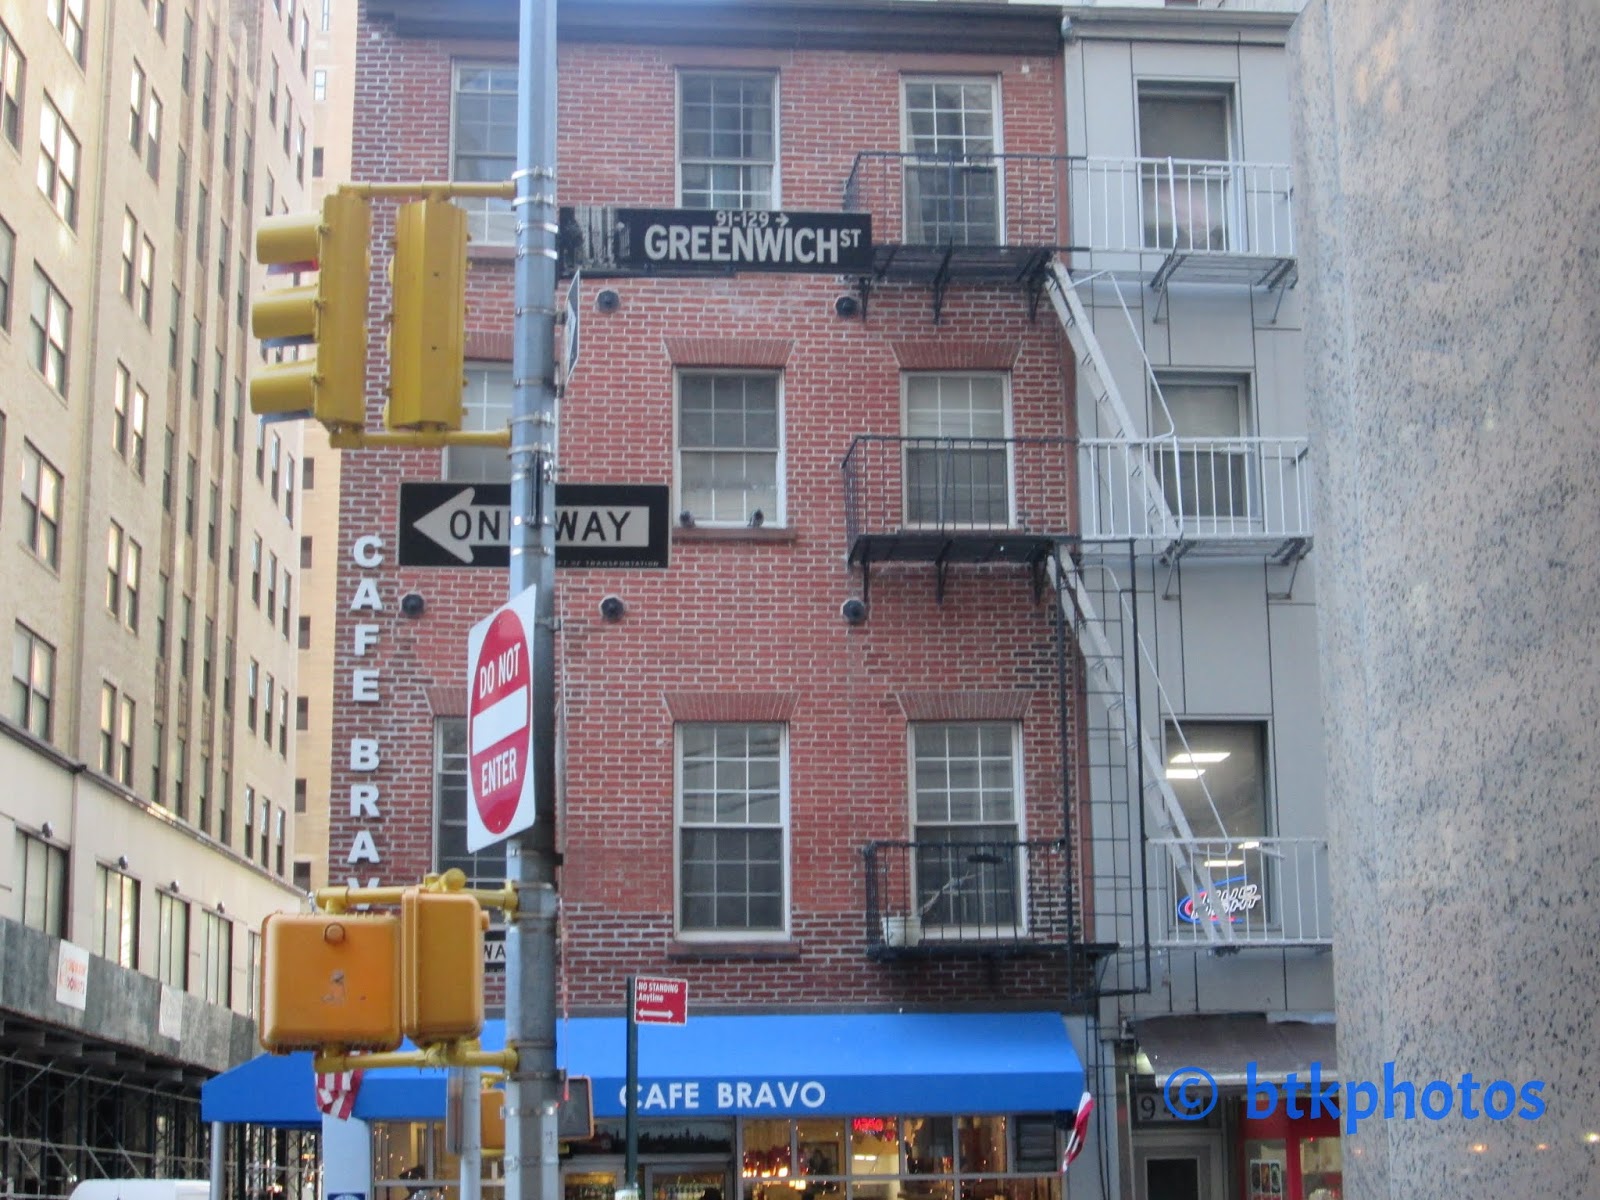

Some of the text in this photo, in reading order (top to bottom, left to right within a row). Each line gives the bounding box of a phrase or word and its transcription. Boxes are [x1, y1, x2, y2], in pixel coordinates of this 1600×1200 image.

[715, 211, 769, 229] 91-129
[644, 224, 861, 264] GREENWICH ST
[449, 509, 631, 542] ON WAY
[479, 642, 521, 699] DO NOT
[347, 534, 384, 911] CAFE BRAV
[481, 747, 518, 798] ENTER
[638, 982, 679, 994] NO STANDING
[638, 993, 664, 1004] Anytime
[619, 1080, 826, 1110] CAFE BRAVO
